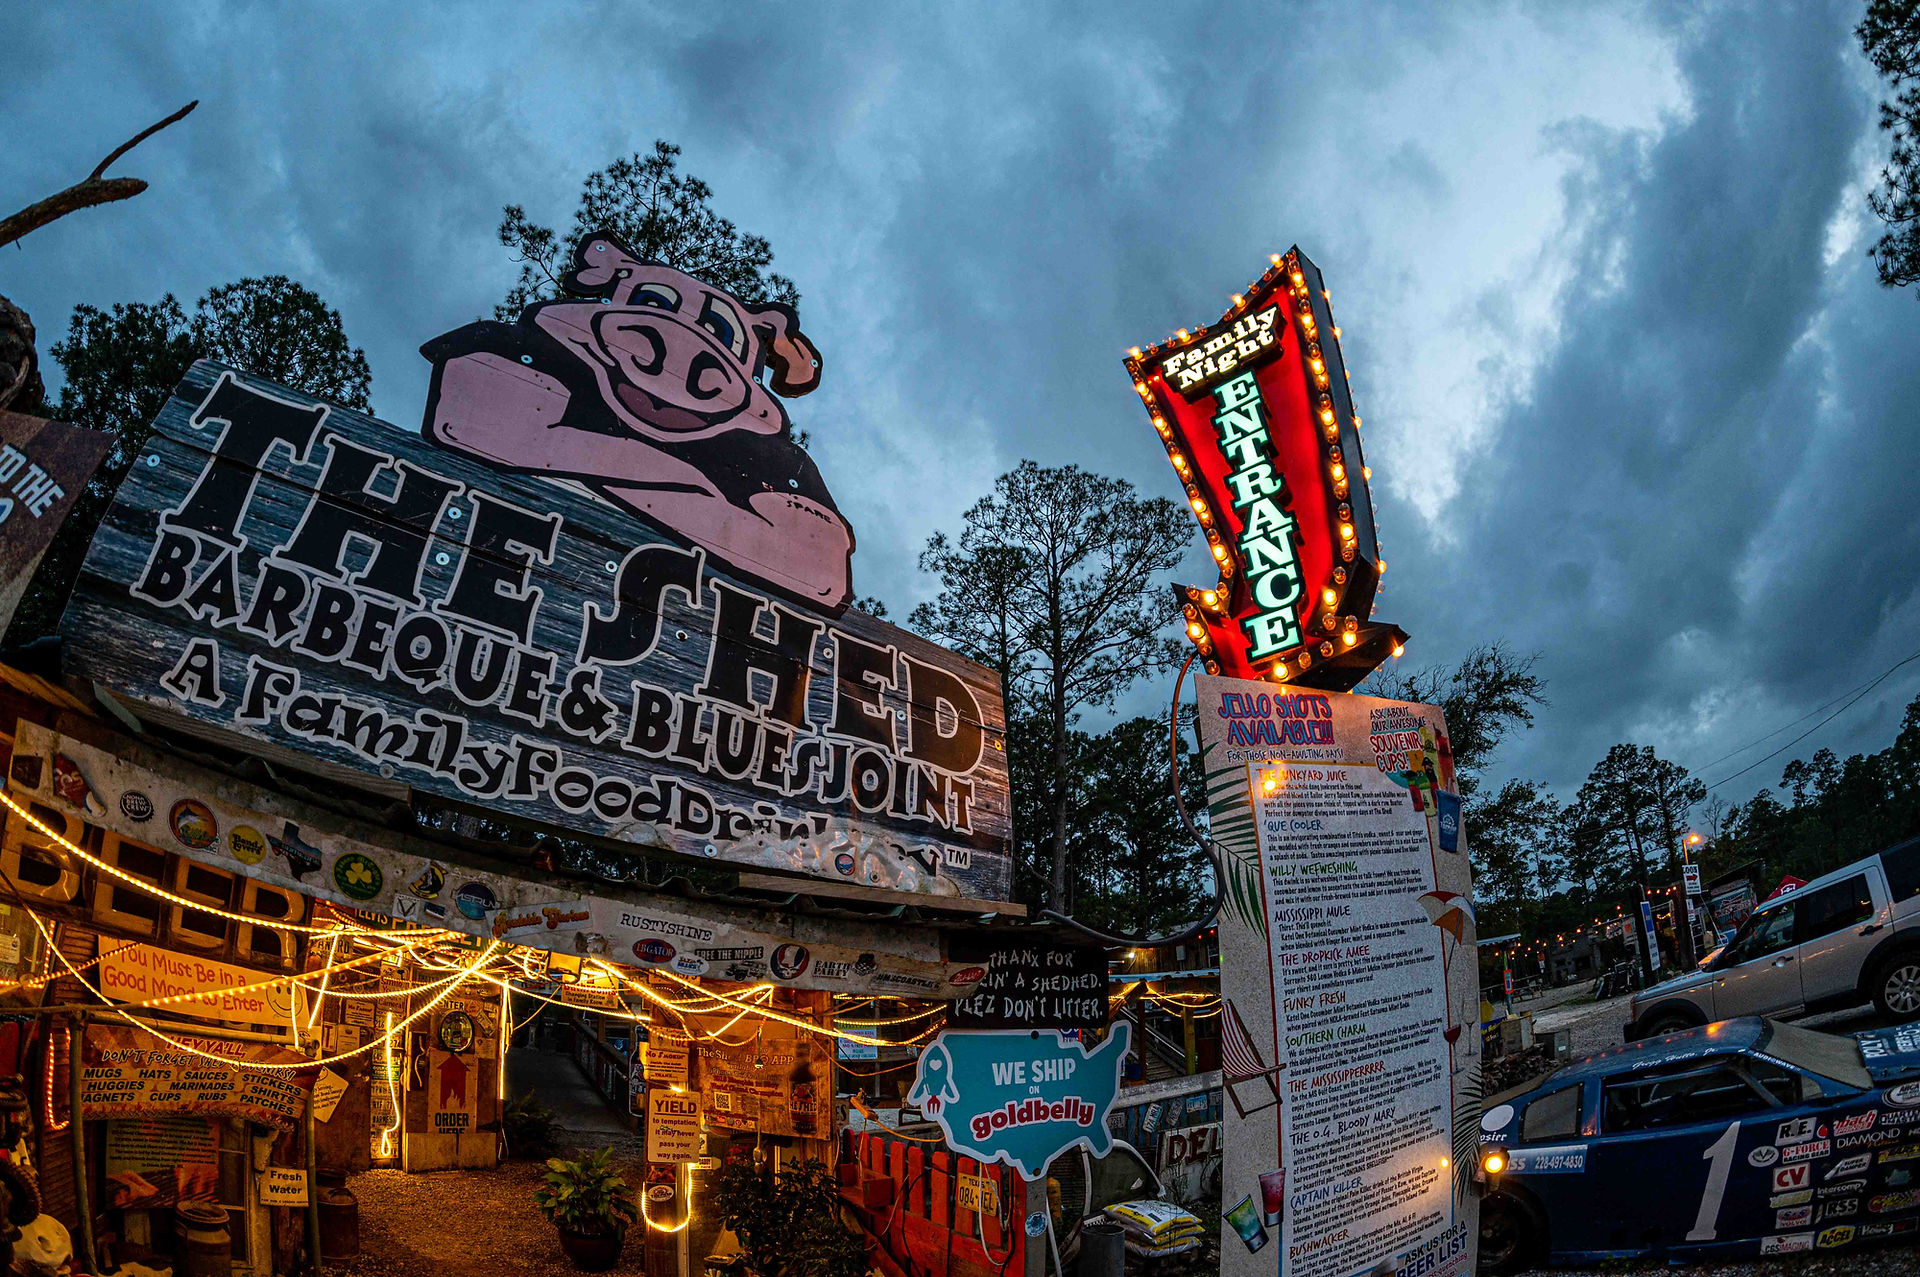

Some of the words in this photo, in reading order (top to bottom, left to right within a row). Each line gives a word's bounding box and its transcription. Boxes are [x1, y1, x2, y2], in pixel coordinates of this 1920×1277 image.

[1163, 305, 1278, 377] Family
[1179, 327, 1275, 391] Night
[11, 462, 66, 519] THE
[1215, 370, 1301, 659] ENTRANCE
[160, 371, 563, 648] THE
[576, 543, 986, 777] SHED
[130, 523, 557, 728] BARBEQUE
[556, 664, 618, 744] &
[621, 680, 823, 798] BLUES
[819, 741, 977, 836] JOINT
[1218, 693, 1271, 719] JELLO
[1273, 693, 1332, 719] SHOTS
[1370, 708, 1385, 720] ASK
[1386, 706, 1409, 719] ABOUT
[161, 638, 225, 707] A
[234, 655, 517, 800] Family
[503, 734, 687, 827] Food
[1227, 720, 1336, 746] AVAILABLE!!!
[1371, 720, 1389, 732] OUR
[1389, 716, 1426, 730] AWESOME
[1369, 731, 1424, 754] SOUVENIR
[1227, 750, 1243, 762] FOR
[1244, 749, 1267, 761] THOSE
[1269, 748, 1324, 760] NON-ADULTING
[1326, 748, 1344, 759] DAYS!
[1376, 751, 1409, 773] CUPS!
[1279, 769, 1323, 782] JUNKYARD
[1326, 769, 1348, 782] JUICE
[1289, 819, 1324, 831] COOLER
[947, 848, 969, 866] TM
[1269, 864, 1297, 878] WILLY
[1300, 861, 1358, 876] WEFWESHING
[1274, 908, 1323, 923] MISSISSIPPI
[1326, 905, 1351, 918] MULE
[620, 913, 713, 941] RUSTYSHINE
[1046, 950, 1074, 968] FOR
[1278, 953, 1299, 967] THE
[1302, 948, 1343, 964] DROPKICK
[1346, 945, 1370, 958] AMEE
[152, 951, 191, 978] Must
[194, 963, 215, 984] Be
[220, 968, 234, 986] in
[239, 975, 246, 987] a
[104, 965, 147, 993] Good
[222, 995, 265, 1012] Enter
[1014, 972, 1025, 988] A
[1031, 973, 1102, 993] SHEDHED.
[1003, 996, 1047, 1021] DON'T
[1053, 997, 1103, 1020] LITTER.
[1282, 995, 1315, 1013] FUNKY
[1319, 991, 1346, 1007] FRESH
[1285, 1030, 1334, 1049] SOUTHERN
[1337, 1023, 1367, 1040] CHARM
[102, 1049, 146, 1064] DON'T
[146, 1051, 197, 1066] FORGET
[697, 1047, 715, 1058] The
[771, 1055, 794, 1066] APP
[83, 1068, 122, 1078] MUGS
[138, 1069, 172, 1080] HATS
[183, 1070, 229, 1081] SAUCES
[242, 1073, 303, 1096] STICKERS
[991, 1061, 1026, 1086] WE
[1031, 1058, 1076, 1083] SHIP
[87, 1080, 145, 1092] HUGGIES
[169, 1081, 235, 1091] MARINADES
[250, 1085, 296, 1105] SHIRTS
[1029, 1085, 1040, 1095] ON
[1287, 1079, 1308, 1093] THE
[149, 1092, 182, 1102] CUPS
[197, 1092, 227, 1101] RUBS
[239, 1094, 295, 1116] PATCHES
[654, 1099, 697, 1114] YIELD
[434, 1112, 469, 1127] ORDER
[652, 1117, 660, 1125] to
[661, 1118, 698, 1127] temptation,
[971, 1098, 1095, 1140] goldbelly
[1289, 1133, 1310, 1146] THE
[1313, 1126, 1334, 1139] O.G.
[1338, 1115, 1370, 1135] BLOODY
[1373, 1107, 1396, 1123] MARY
[659, 1141, 675, 1149] pass
[1783, 1140, 1829, 1157] G-FORCE
[1837, 1128, 1900, 1149] DIAMOND
[657, 1152, 671, 1160] way
[270, 1170, 302, 1181] Fresh
[1685, 1121, 1741, 1241] 1
[1777, 1167, 1806, 1188] CV
[269, 1184, 302, 1195] Water
[1290, 1184, 1330, 1209] CAPTAIN
[1333, 1176, 1363, 1192] KILLER
[1817, 1182, 1861, 1195] Intercomp
[1289, 1229, 1349, 1259] BUSHWACKER
[1404, 1247, 1424, 1264] ASK
[1426, 1237, 1439, 1251] US
[1440, 1226, 1459, 1243] FOR
[1459, 1220, 1466, 1231] A
[1439, 1232, 1468, 1264] LIST
[1819, 1229, 1851, 1246] ACCEL
